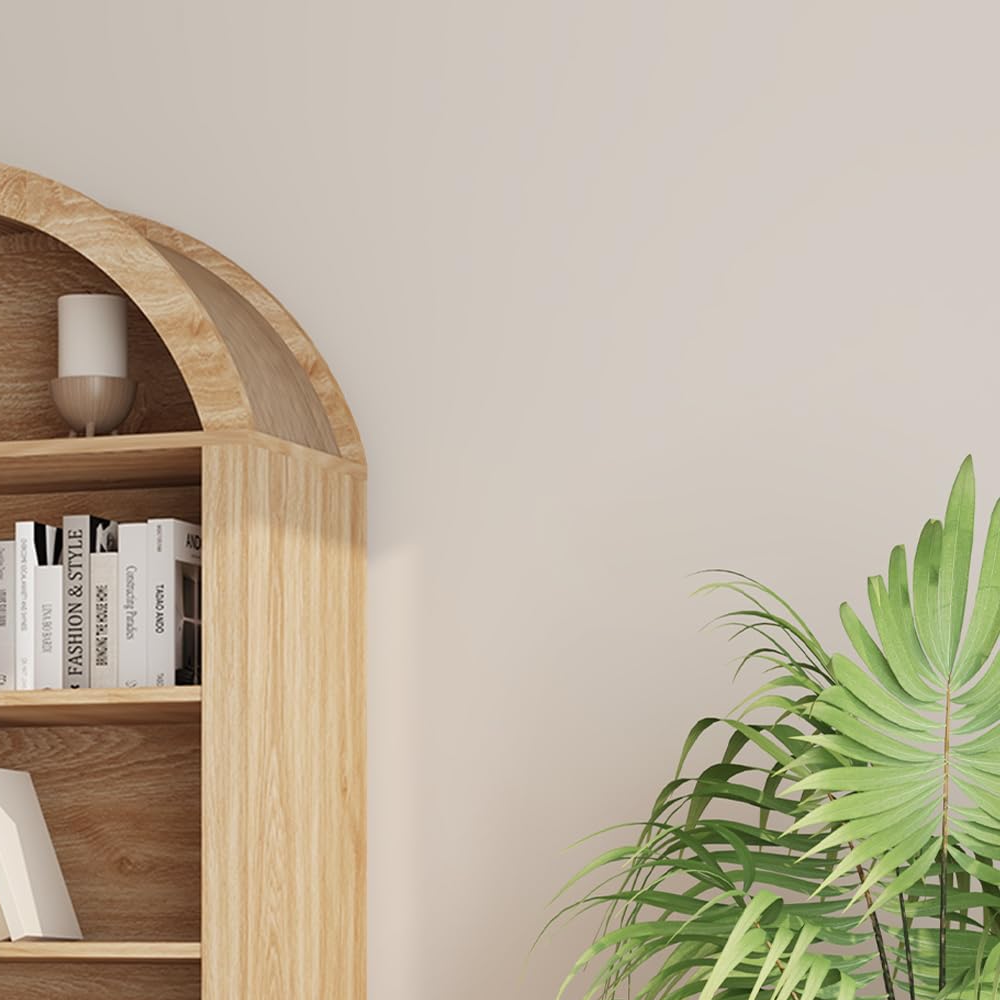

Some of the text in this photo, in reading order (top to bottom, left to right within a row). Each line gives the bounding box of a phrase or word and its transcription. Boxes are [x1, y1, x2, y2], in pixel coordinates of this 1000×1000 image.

[68, 529, 83, 675] FASHION & STYLE
[155, 584, 164, 634] TADAO ANDO
